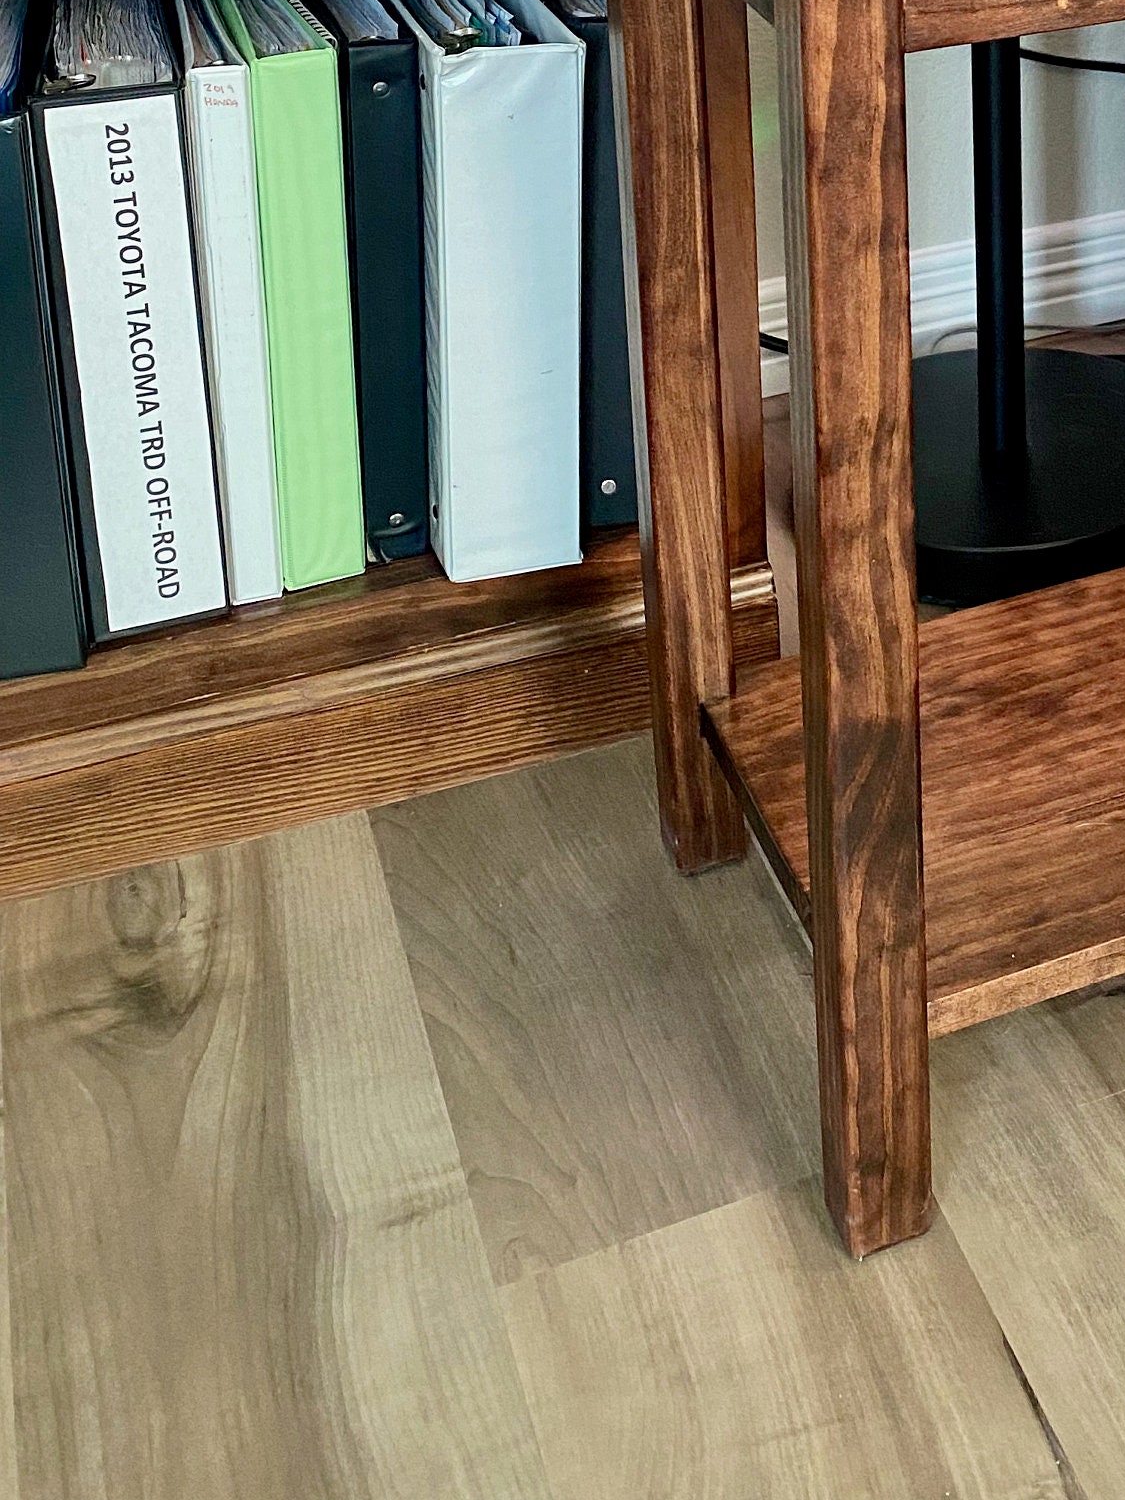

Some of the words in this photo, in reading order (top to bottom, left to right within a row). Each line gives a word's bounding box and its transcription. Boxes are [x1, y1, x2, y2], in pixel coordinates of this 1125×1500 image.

[105, 122, 135, 186] 2013
[113, 191, 147, 300] TOYOTA
[126, 303, 161, 418] TACOMA
[139, 420, 166, 470] TRD
[145, 477, 181, 600] OFF-ROAD
